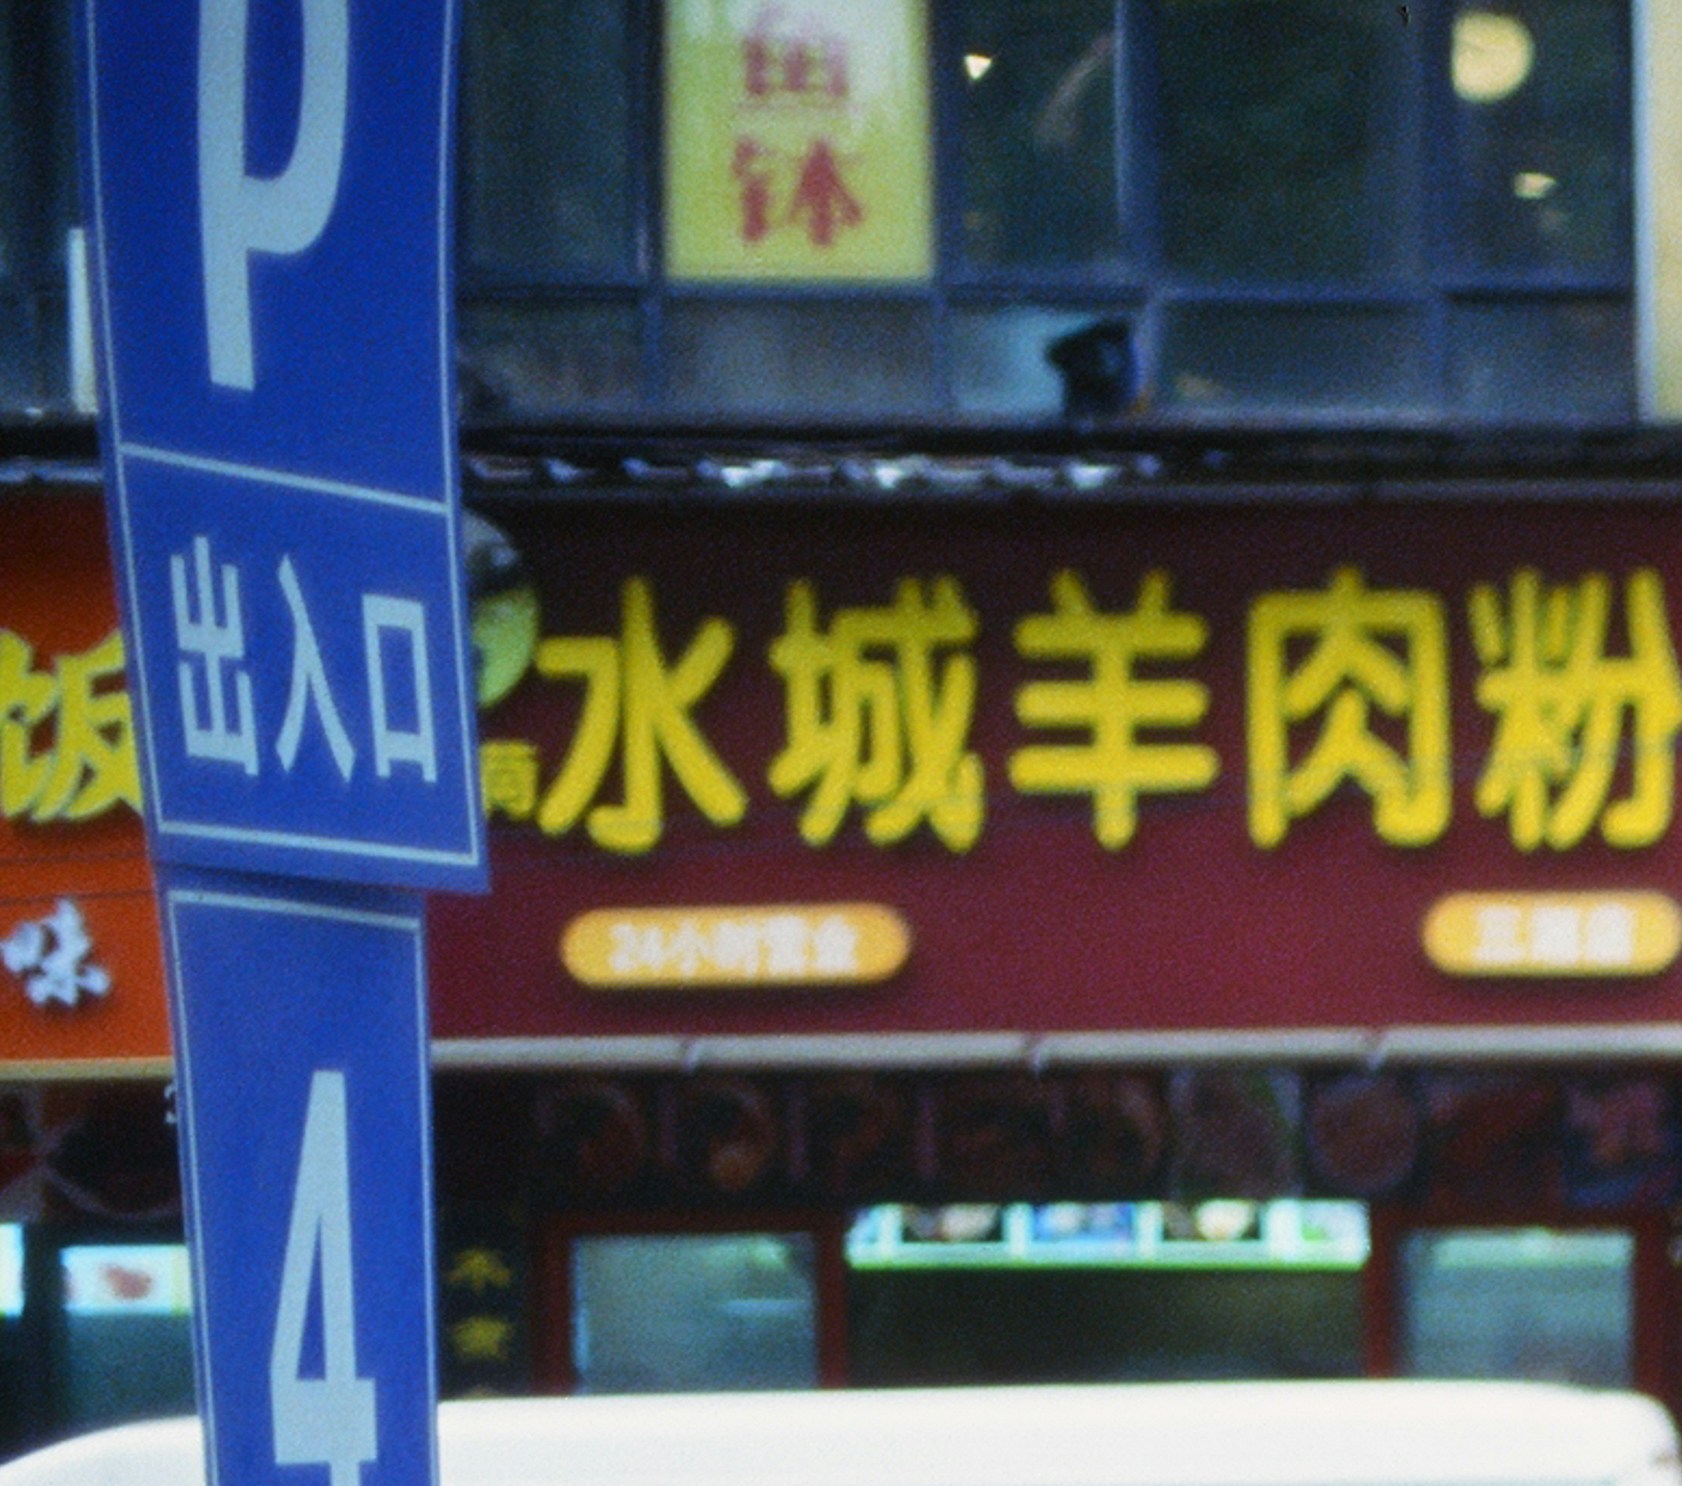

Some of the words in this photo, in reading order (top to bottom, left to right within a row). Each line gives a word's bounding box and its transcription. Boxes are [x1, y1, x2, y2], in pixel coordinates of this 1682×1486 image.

[198, 0, 349, 391] P
[170, 534, 440, 784] 出入口
